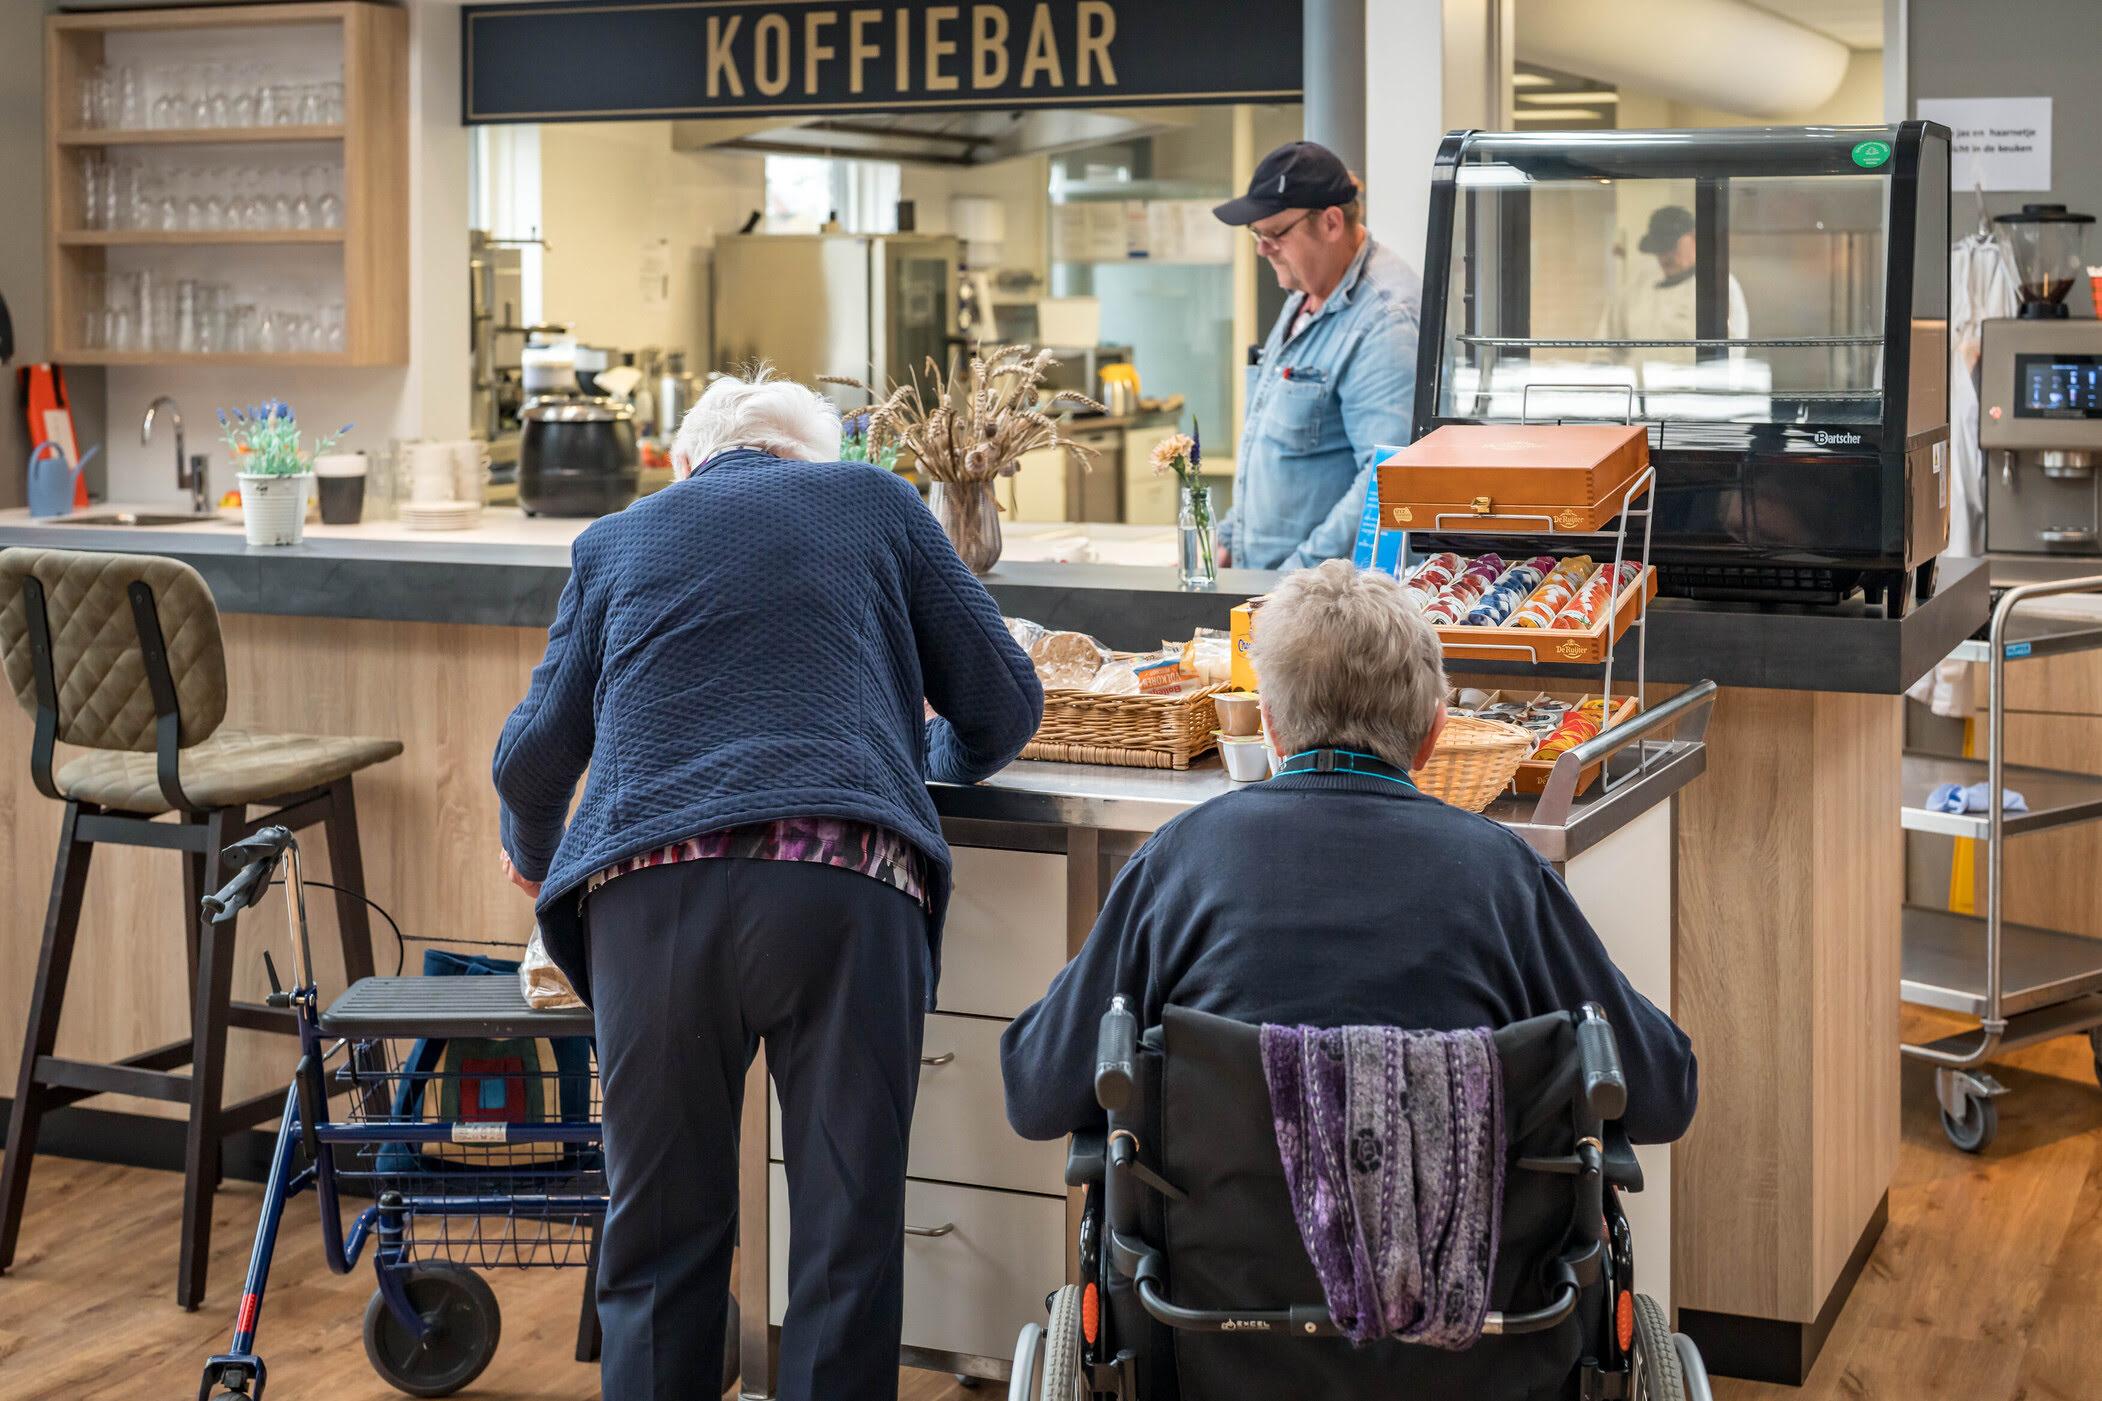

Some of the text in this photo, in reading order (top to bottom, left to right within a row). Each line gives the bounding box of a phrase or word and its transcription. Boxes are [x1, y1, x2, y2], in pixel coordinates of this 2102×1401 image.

[706, 1, 1119, 97] KOFFIEBAR
[1989, 128, 2035, 138] haarnetje
[1983, 144, 1995, 152] de
[1998, 144, 2032, 152] keuken
[1814, 430, 1861, 446] Bartscher
[1142, 672, 1181, 687] VOLKOREN
